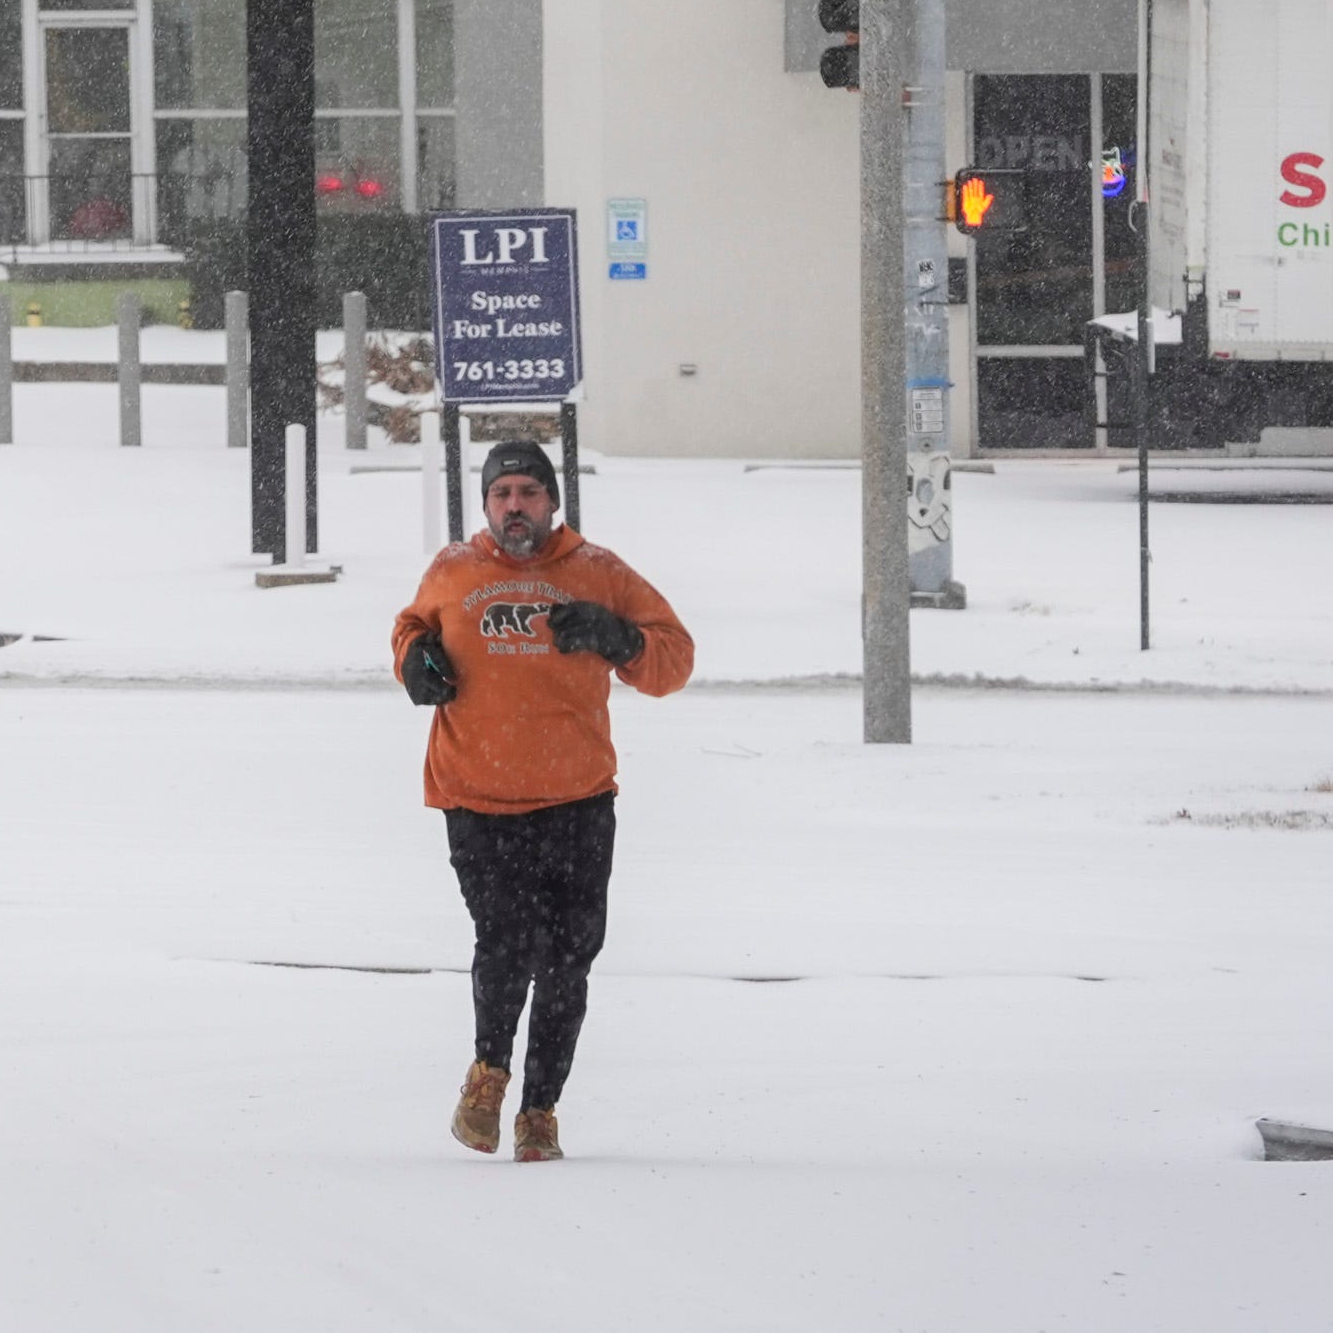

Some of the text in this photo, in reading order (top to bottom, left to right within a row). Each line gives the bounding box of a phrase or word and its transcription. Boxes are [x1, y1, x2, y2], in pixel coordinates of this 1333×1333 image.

[979, 135, 1083, 171] OPEN
[1279, 151, 1327, 209] S
[458, 226, 549, 265] LPI
[1277, 222, 1330, 246] Chi
[471, 290, 541, 315] Space
[453, 318, 563, 339] For Lease
[453, 358, 565, 381] 761-3333
